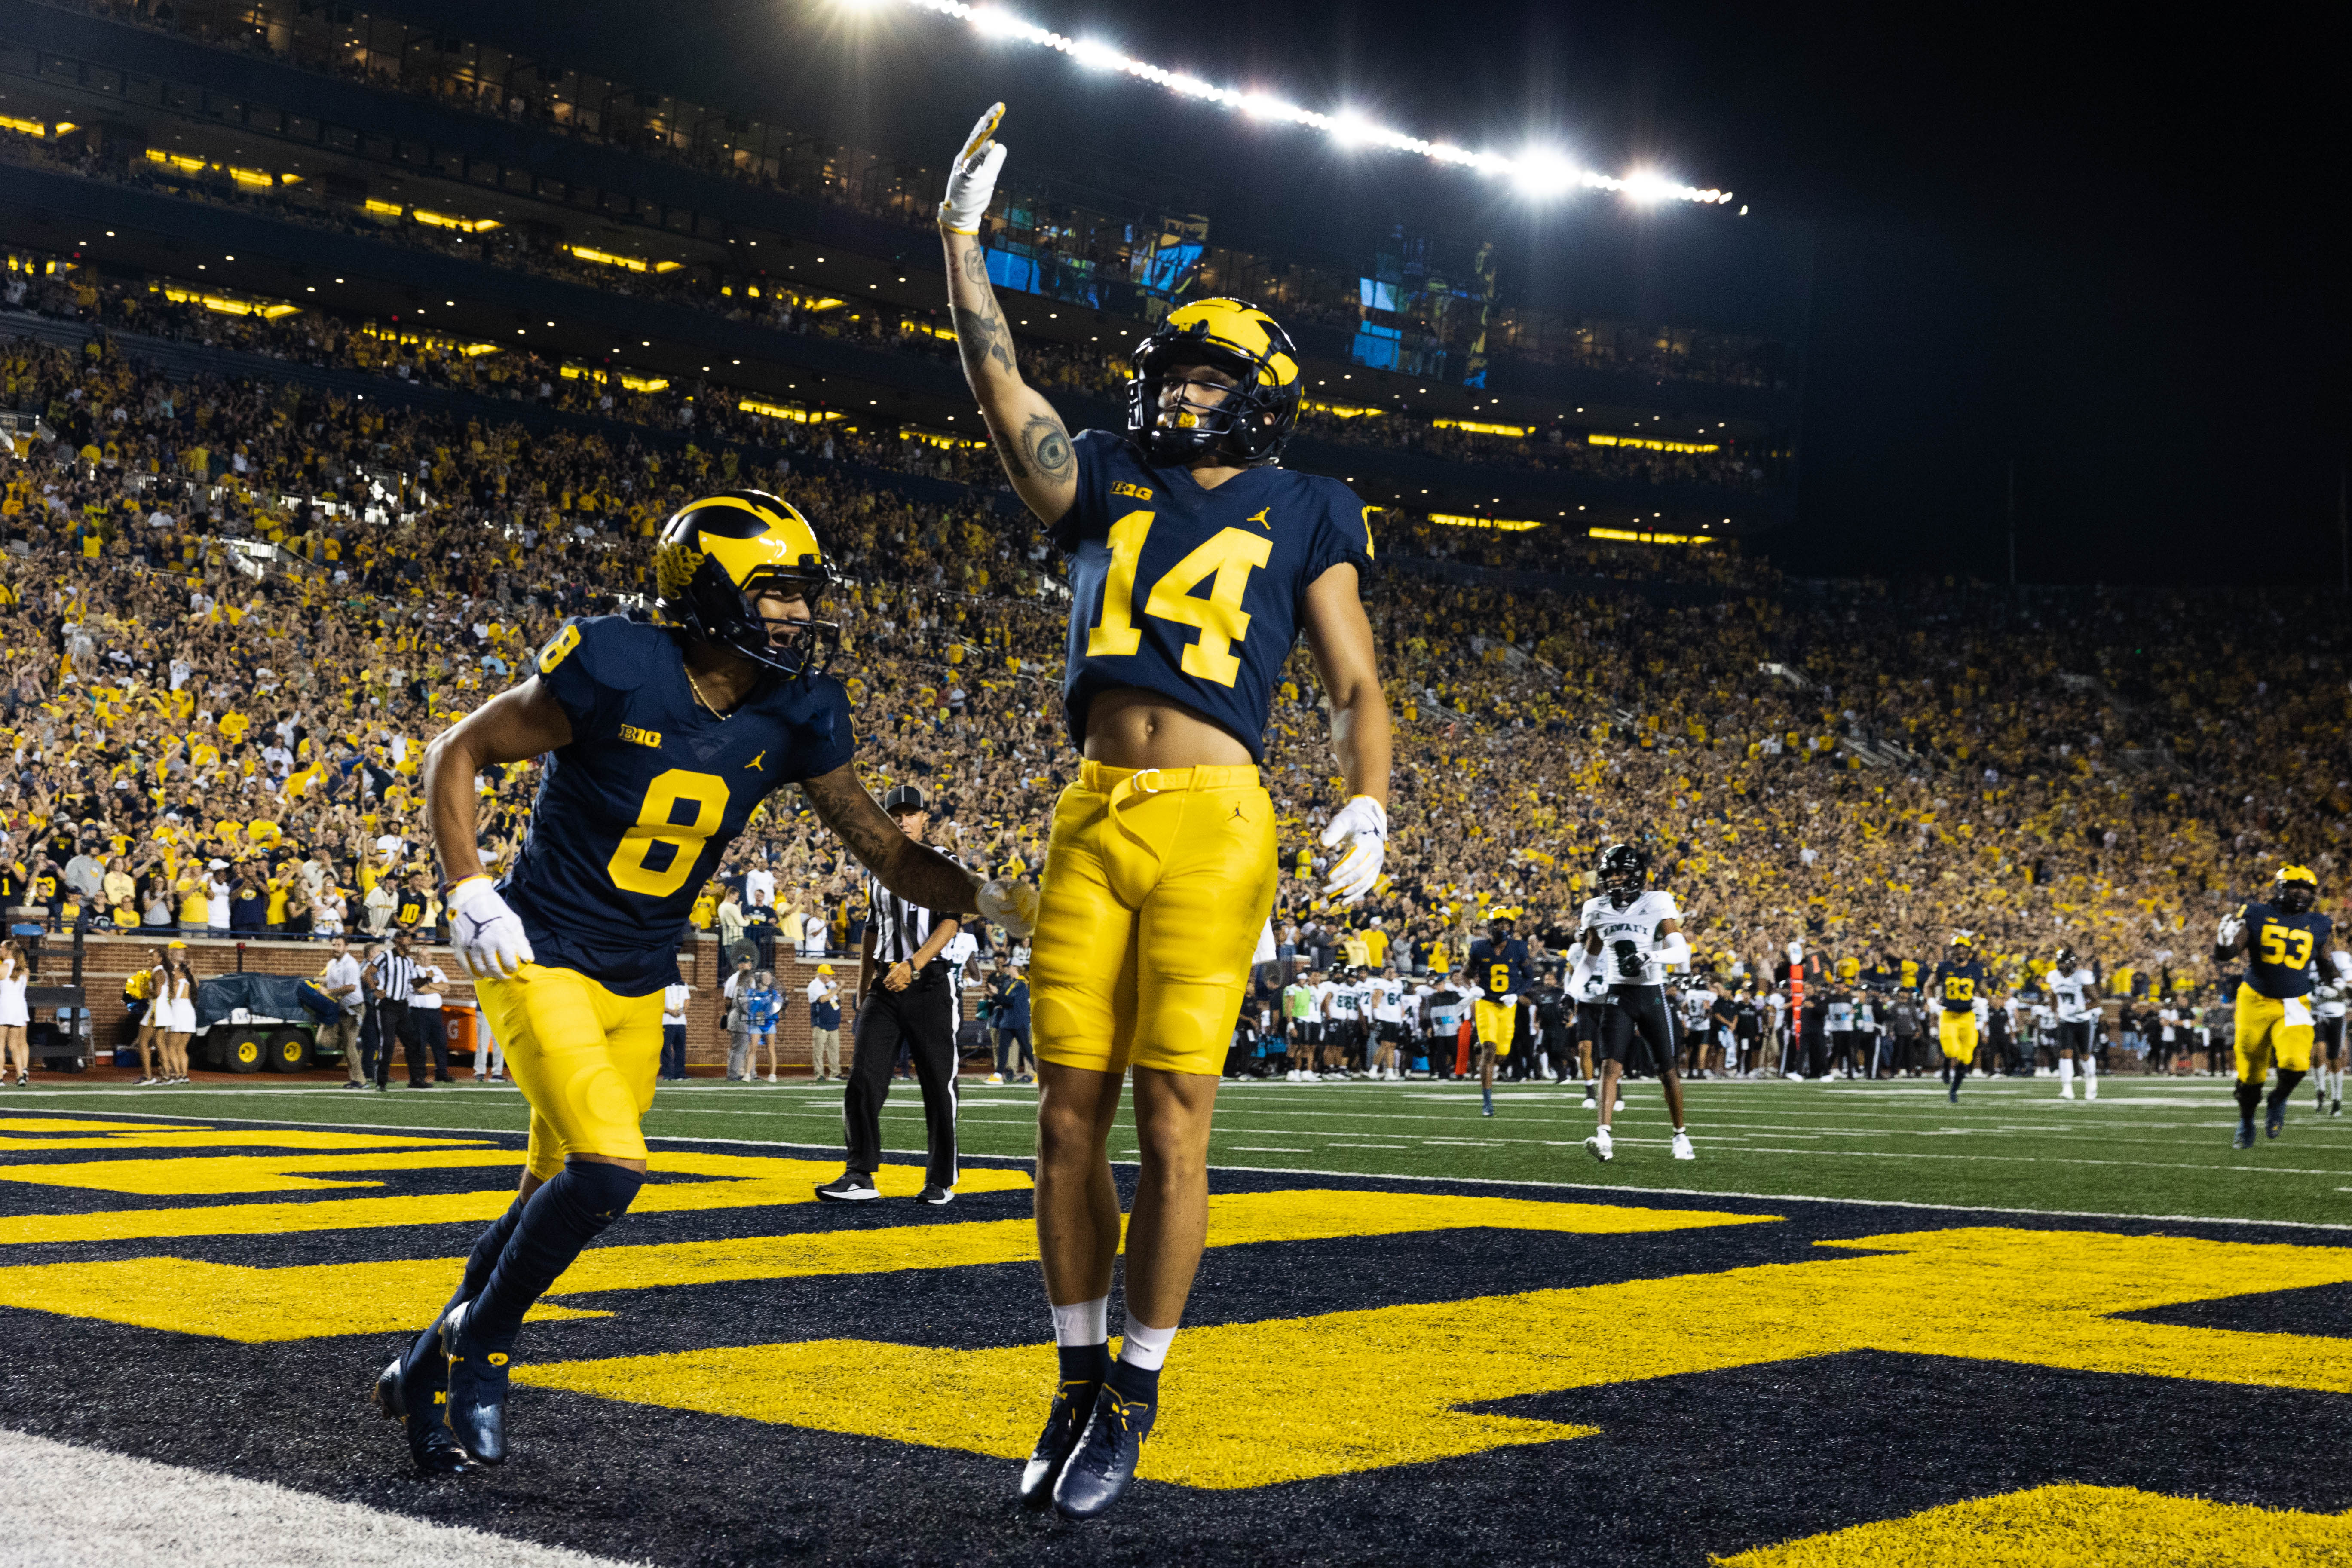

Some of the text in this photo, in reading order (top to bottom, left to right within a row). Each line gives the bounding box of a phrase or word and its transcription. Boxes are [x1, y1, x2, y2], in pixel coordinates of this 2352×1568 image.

[1086, 510, 1273, 688] 14
[538, 624, 582, 674] 8
[607, 768, 730, 897] 8
[2, 878, 11, 897] 1
[399, 903, 421, 924] 10
[2260, 924, 2314, 970] 53
[1490, 963, 1510, 992] 6
[1945, 976, 1975, 1001] 83
[447, 1019, 459, 1039] G
